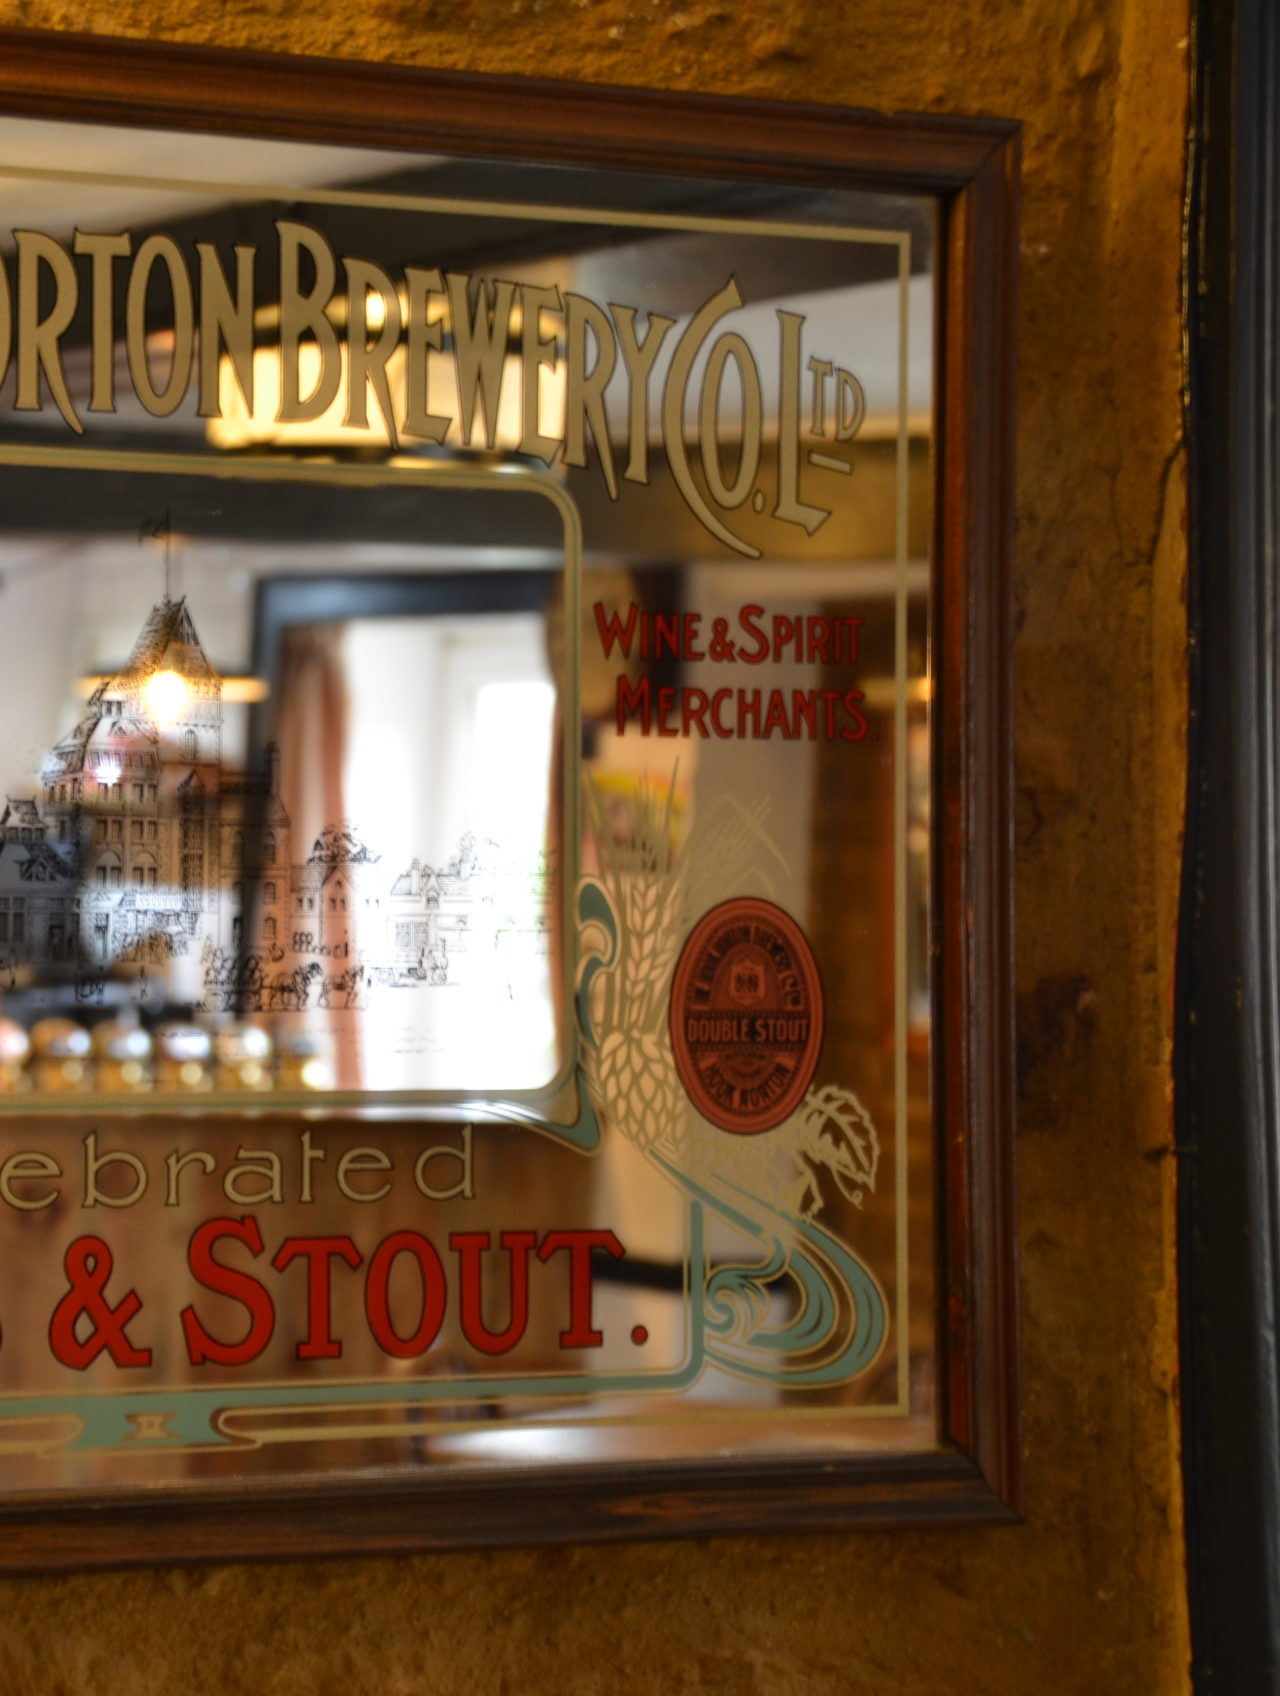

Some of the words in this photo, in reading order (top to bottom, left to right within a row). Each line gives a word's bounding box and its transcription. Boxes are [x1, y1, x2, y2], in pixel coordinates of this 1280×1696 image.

[276, 219, 676, 502] BREWERY
[687, 1019, 750, 1042] DOUBLE
[755, 1019, 809, 1042] STOUT
[48, 1234, 153, 1372] &
